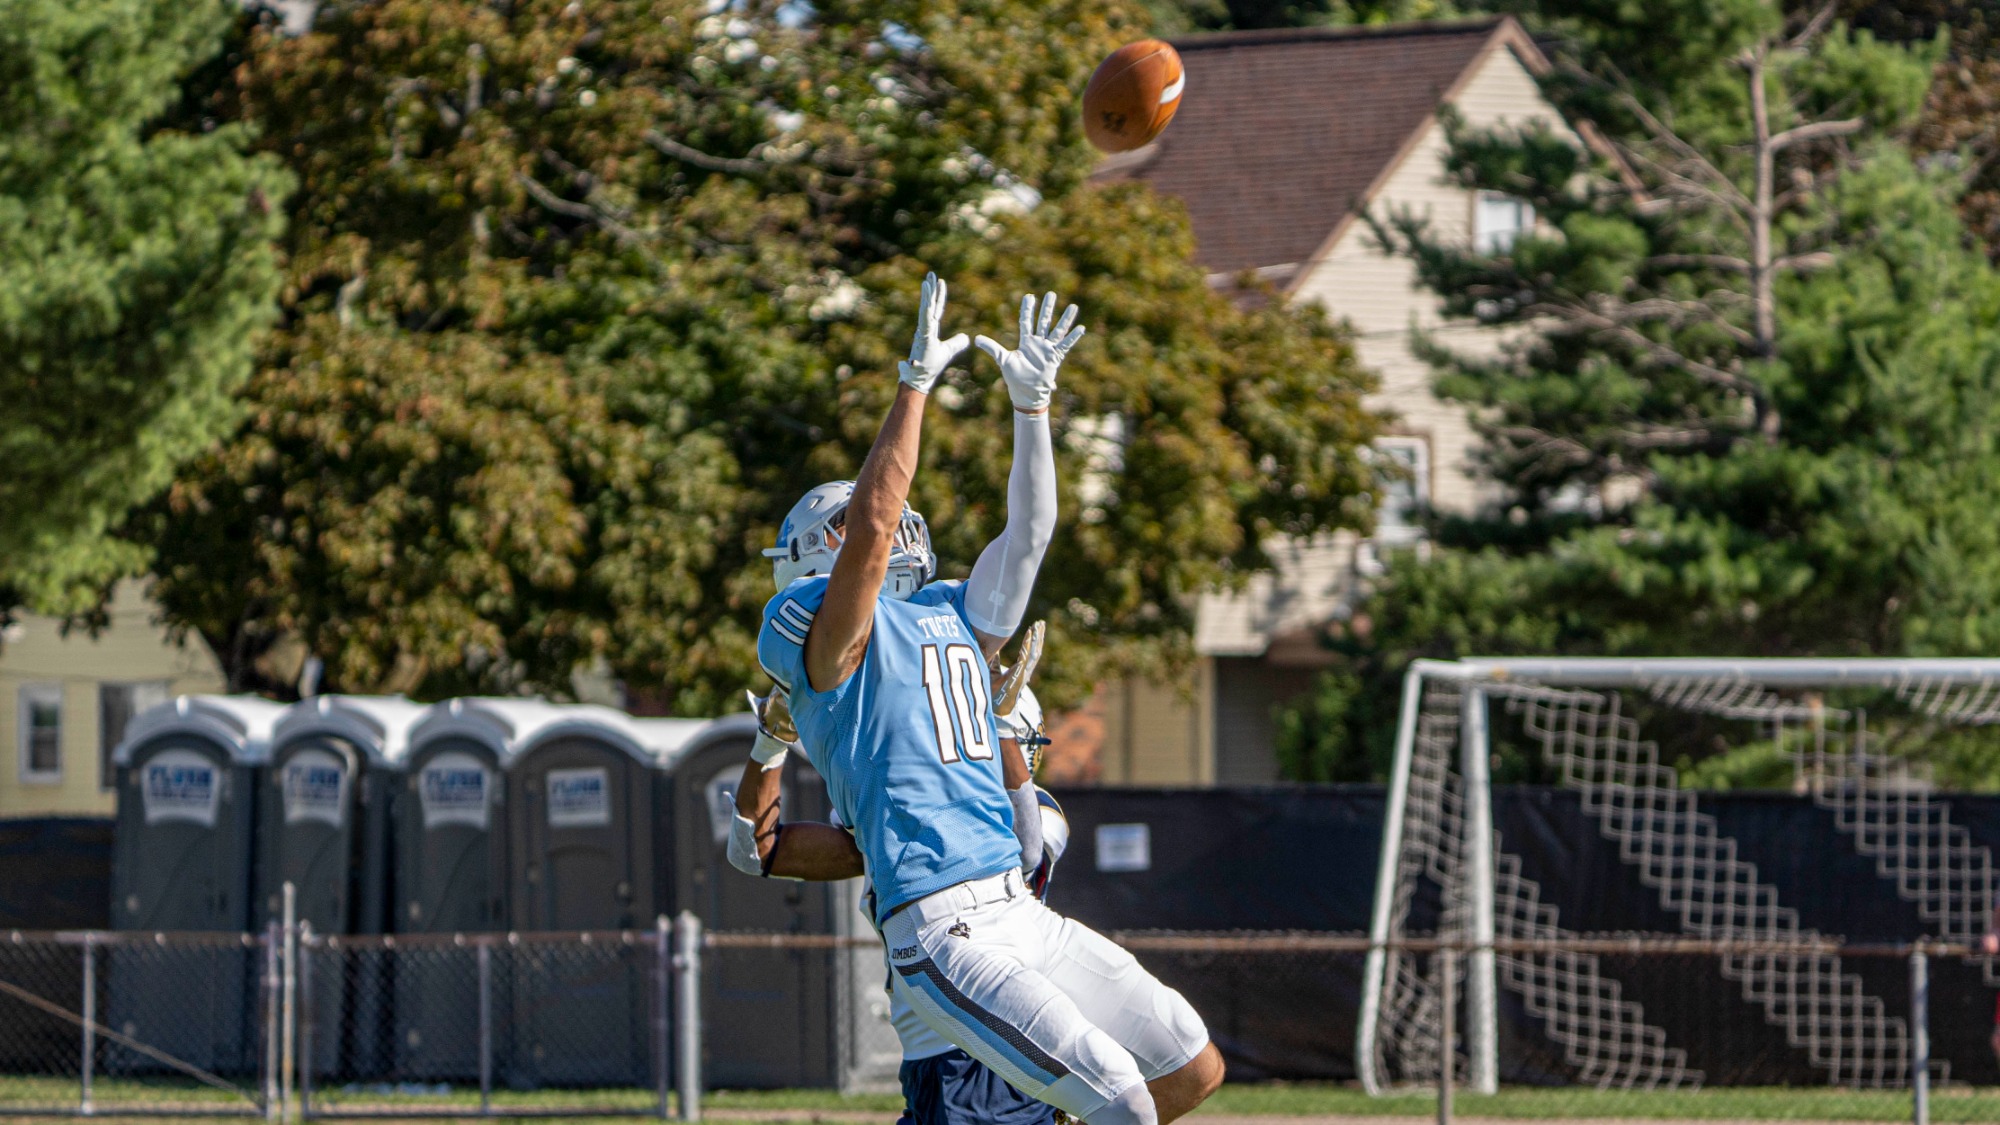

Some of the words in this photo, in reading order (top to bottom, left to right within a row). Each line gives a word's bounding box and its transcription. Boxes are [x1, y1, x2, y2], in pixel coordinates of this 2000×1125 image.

[769, 597, 816, 647] 10
[916, 614, 959, 639] TUFTS
[921, 643, 993, 764] 10
